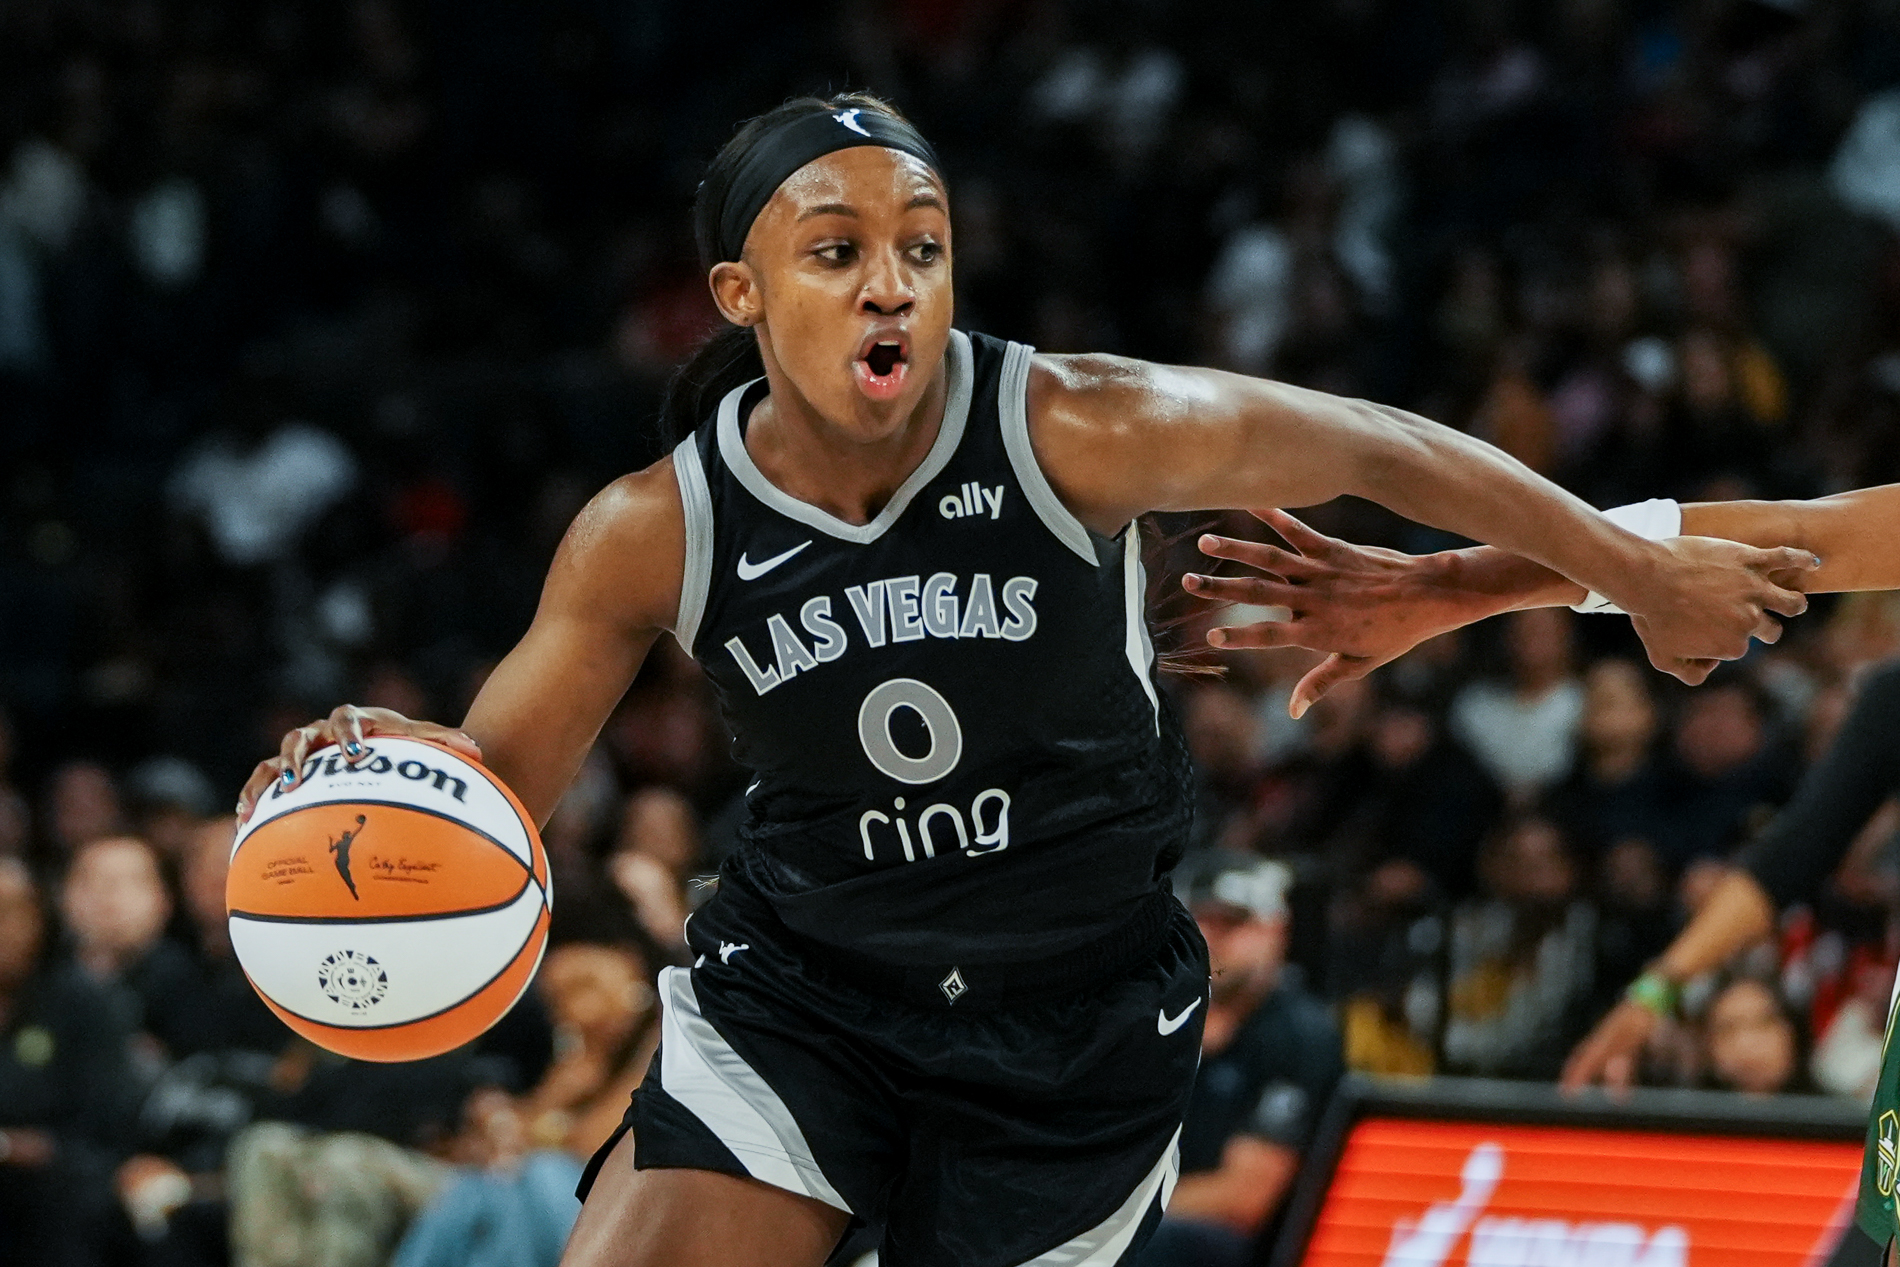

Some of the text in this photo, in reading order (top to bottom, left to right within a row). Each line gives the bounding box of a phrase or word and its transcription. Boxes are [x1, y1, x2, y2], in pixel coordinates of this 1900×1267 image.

[938, 481, 1005, 520] ally
[724, 572, 1038, 696] LAS VEGAS
[857, 677, 963, 785] 0
[859, 788, 1012, 862] ring
